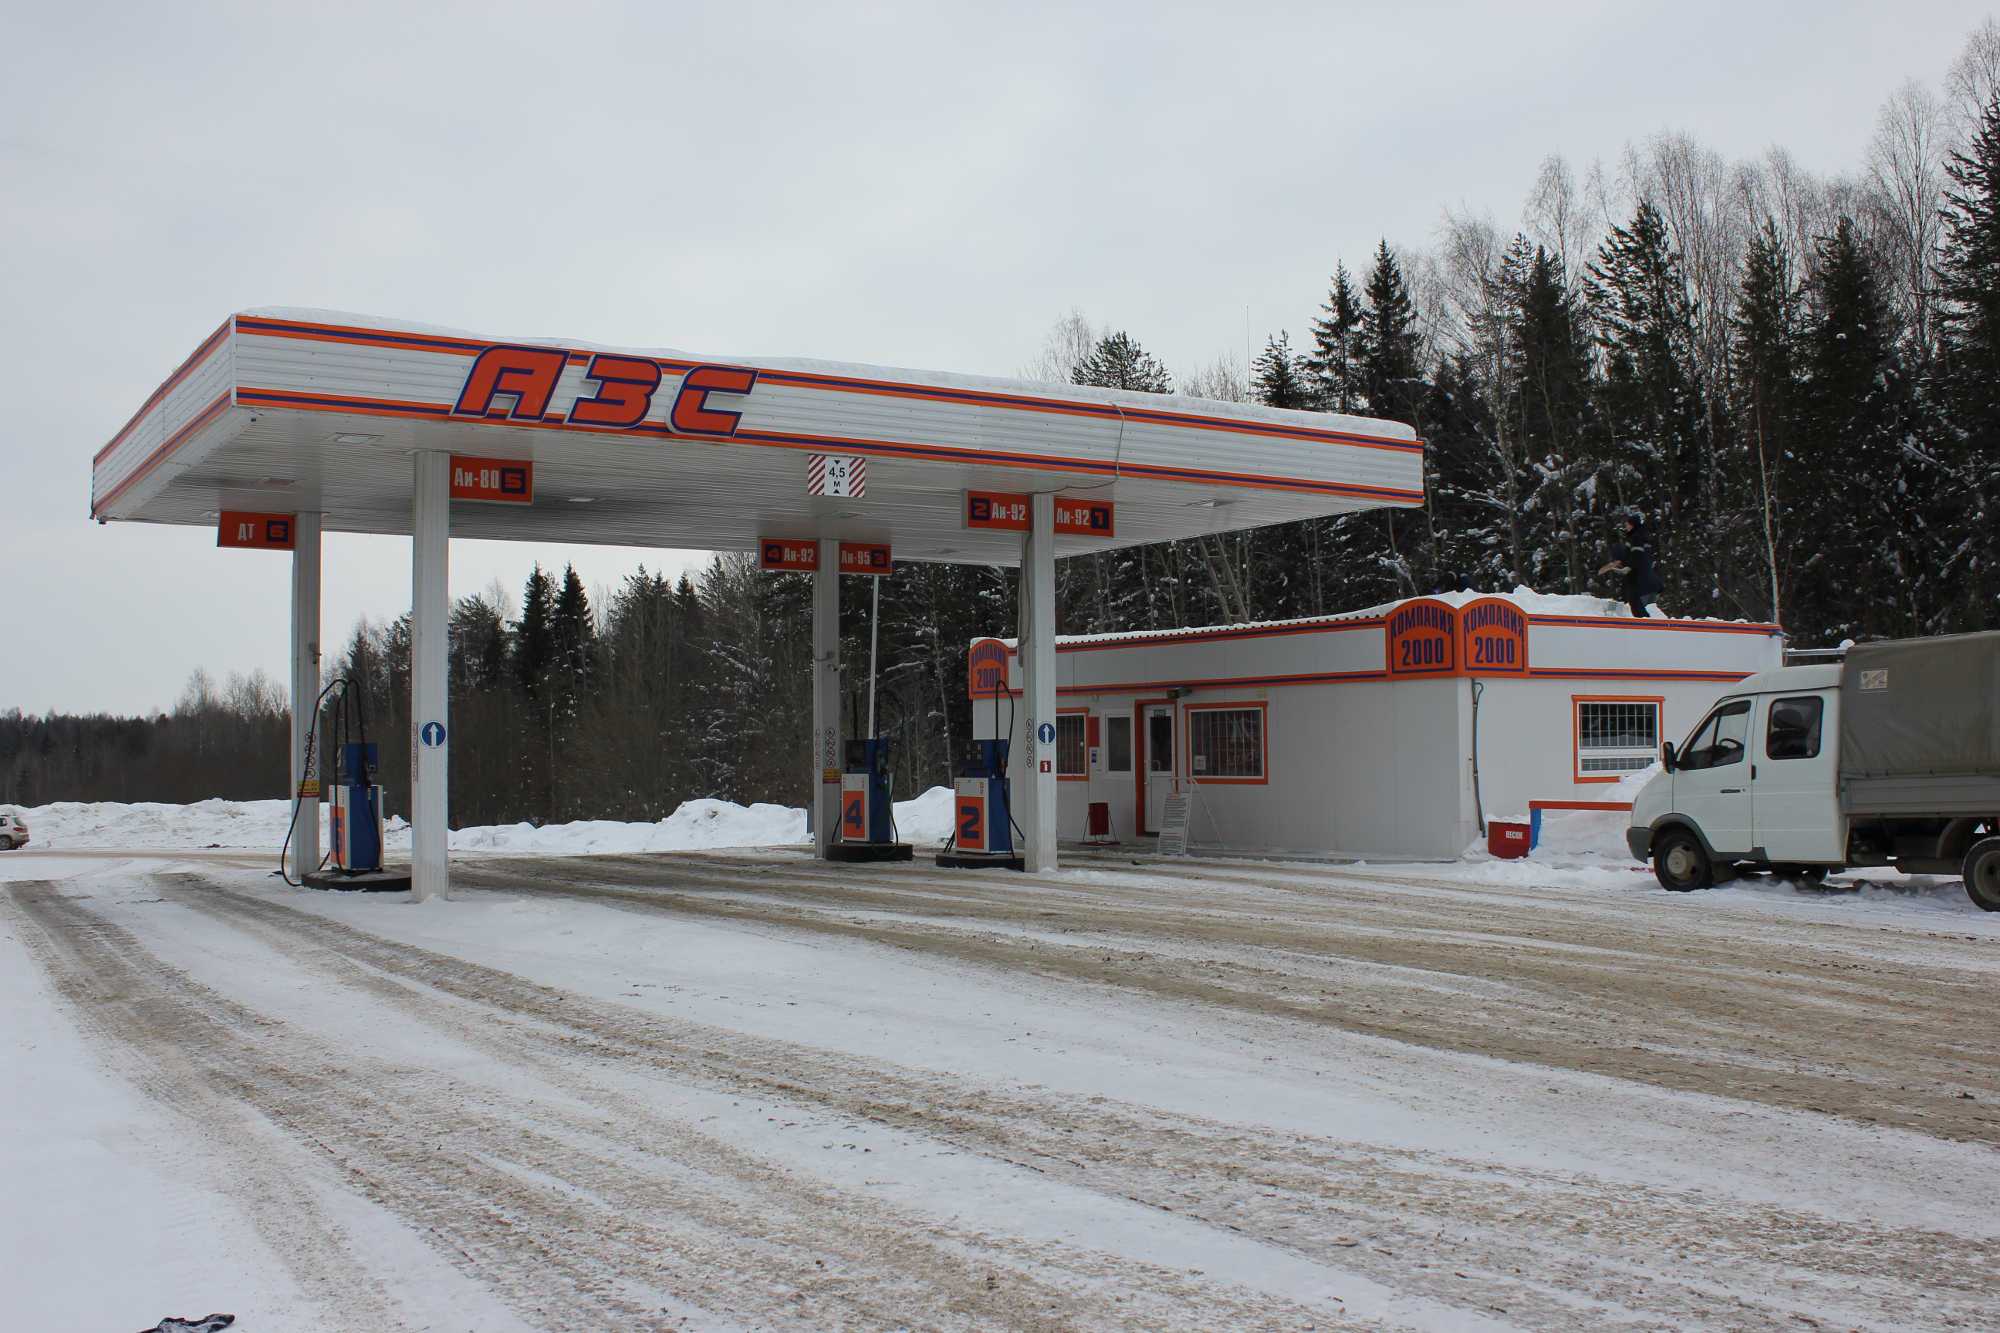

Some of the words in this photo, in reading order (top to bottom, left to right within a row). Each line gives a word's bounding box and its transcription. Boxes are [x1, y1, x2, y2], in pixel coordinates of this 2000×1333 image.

[451, 344, 759, 438] АЗС
[991, 502, 1026, 521] Аи-92
[1056, 507, 1090, 526] Аи-92
[1402, 638, 1445, 666] 2000
[1475, 636, 1516, 664] 2000
[845, 799, 862, 829] 4
[961, 806, 980, 839] 2
